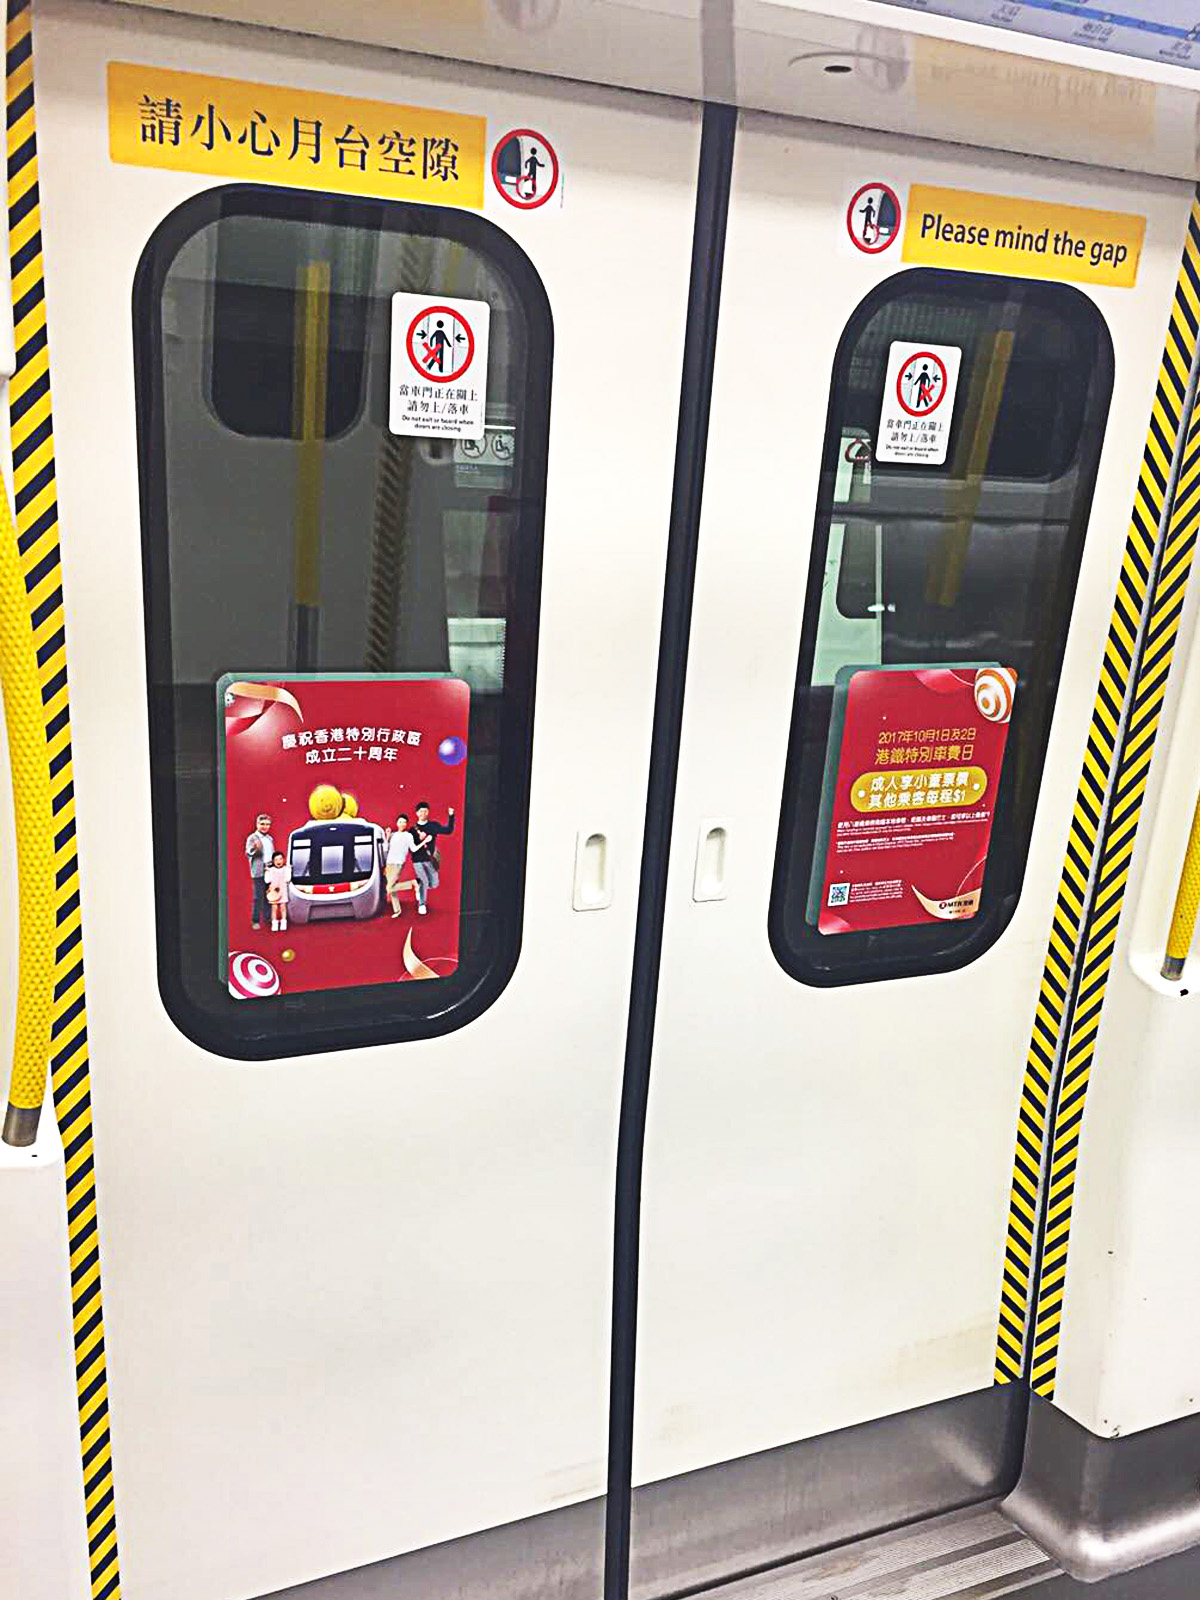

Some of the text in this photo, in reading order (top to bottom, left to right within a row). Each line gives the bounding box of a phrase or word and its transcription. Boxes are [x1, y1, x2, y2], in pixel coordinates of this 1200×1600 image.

[138, 94, 459, 182] 請小心月台空隙
[920, 213, 1128, 268] Please mind the gap
[281, 727, 422, 750] 慶祝香港特別行政區
[878, 727, 977, 745] 2017年10月1日及2日
[305, 746, 399, 765] 成立二十周年
